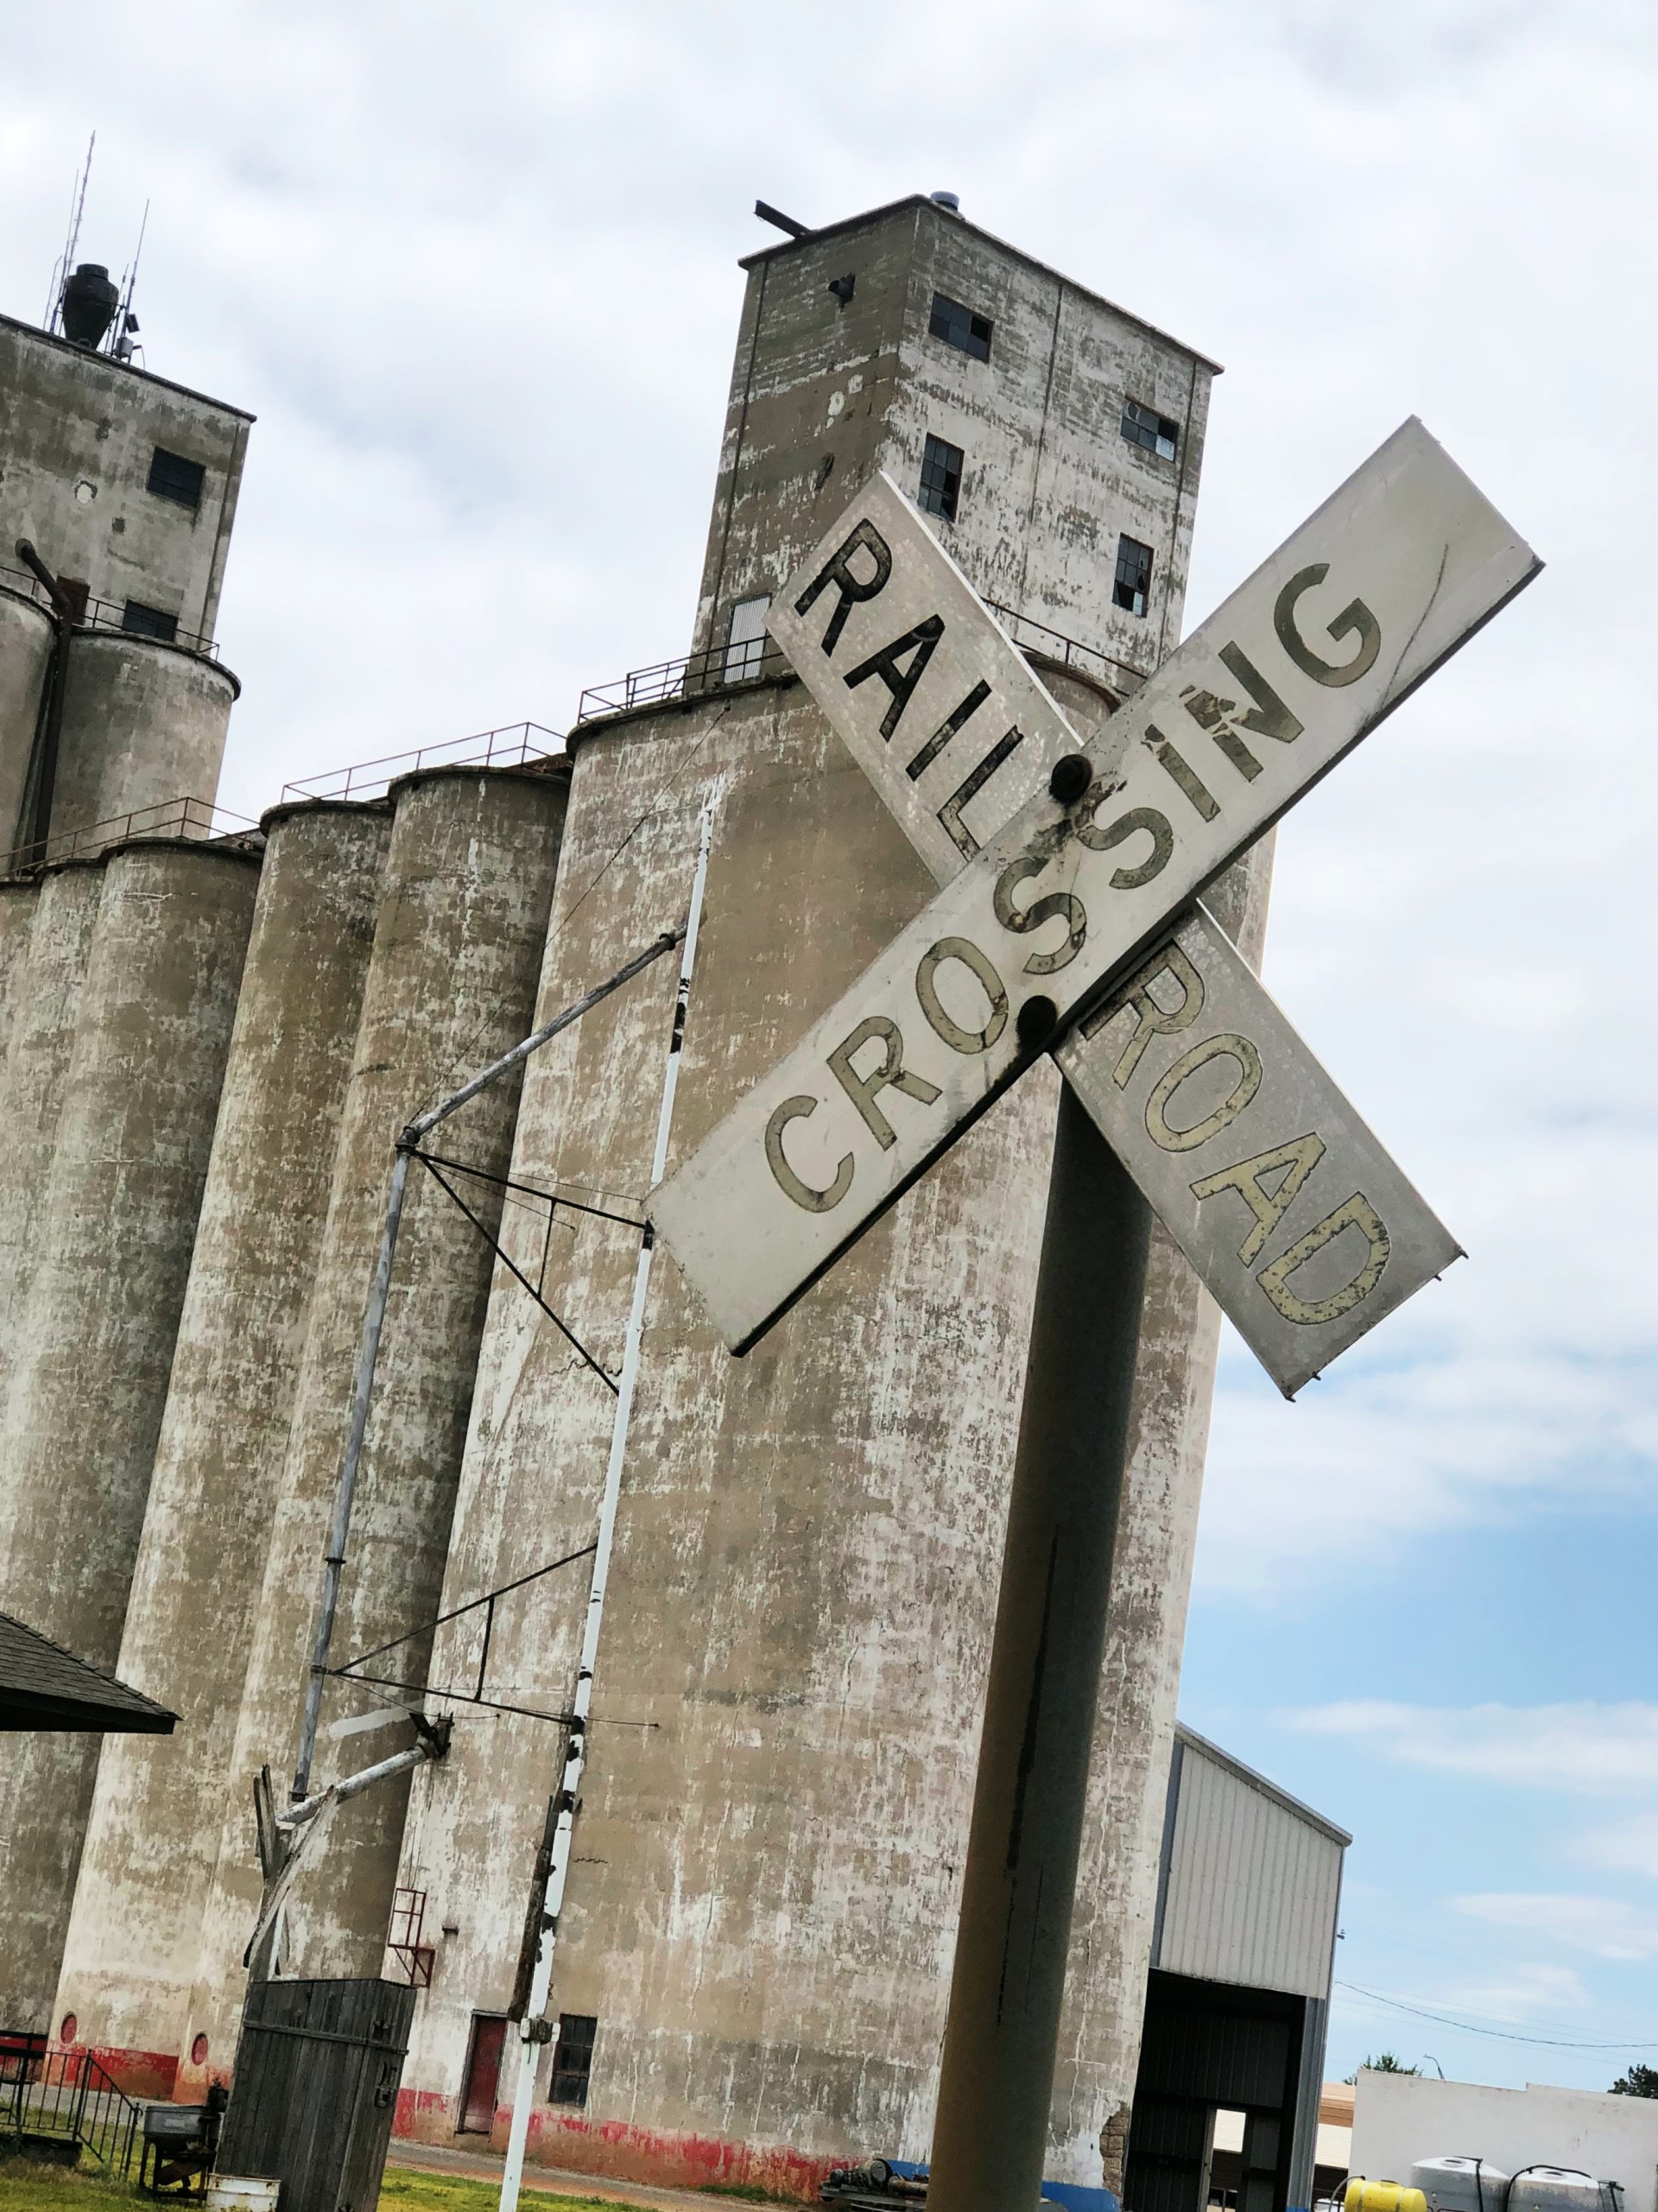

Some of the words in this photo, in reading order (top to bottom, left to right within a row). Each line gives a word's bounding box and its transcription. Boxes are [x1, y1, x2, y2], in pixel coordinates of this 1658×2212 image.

[764, 563, 1382, 1213] CROSSING
[794, 518, 1025, 863] RAIL
[1079, 938, 1390, 1325] ROAD
